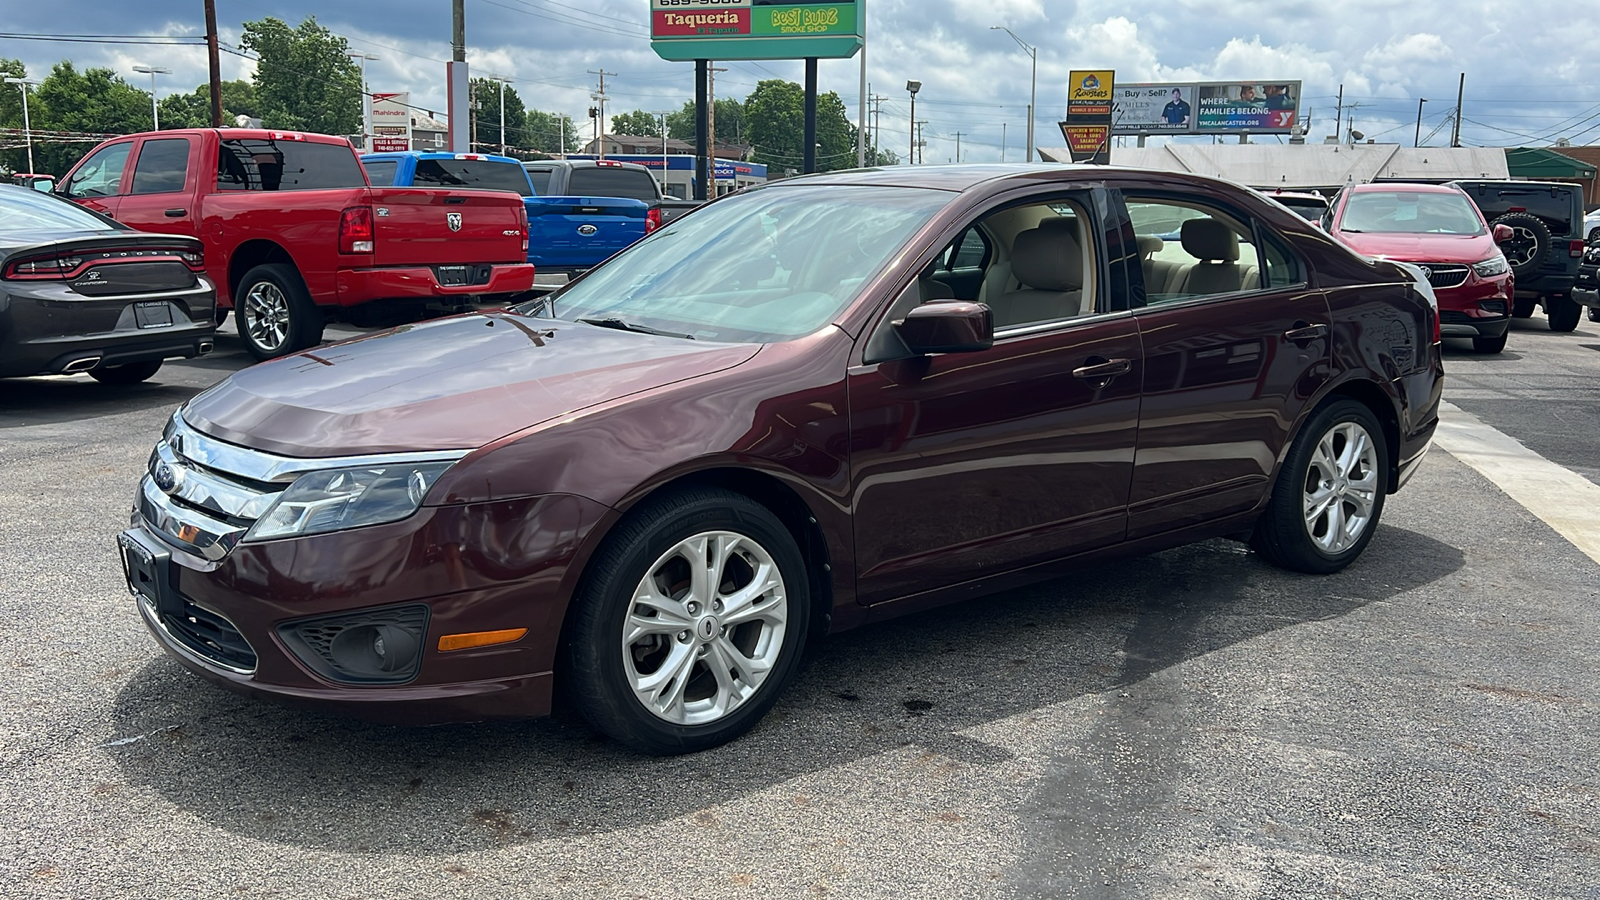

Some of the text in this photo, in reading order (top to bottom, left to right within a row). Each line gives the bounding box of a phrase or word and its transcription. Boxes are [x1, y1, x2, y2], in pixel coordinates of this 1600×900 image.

[781, 25, 828, 34] SMOKE SHOP
[1074, 88, 1108, 99] Roosters
[1125, 90, 1140, 98] Buy
[1148, 89, 1167, 97] Sell?
[1200, 107, 1271, 115] FAMILIES BELONG.
